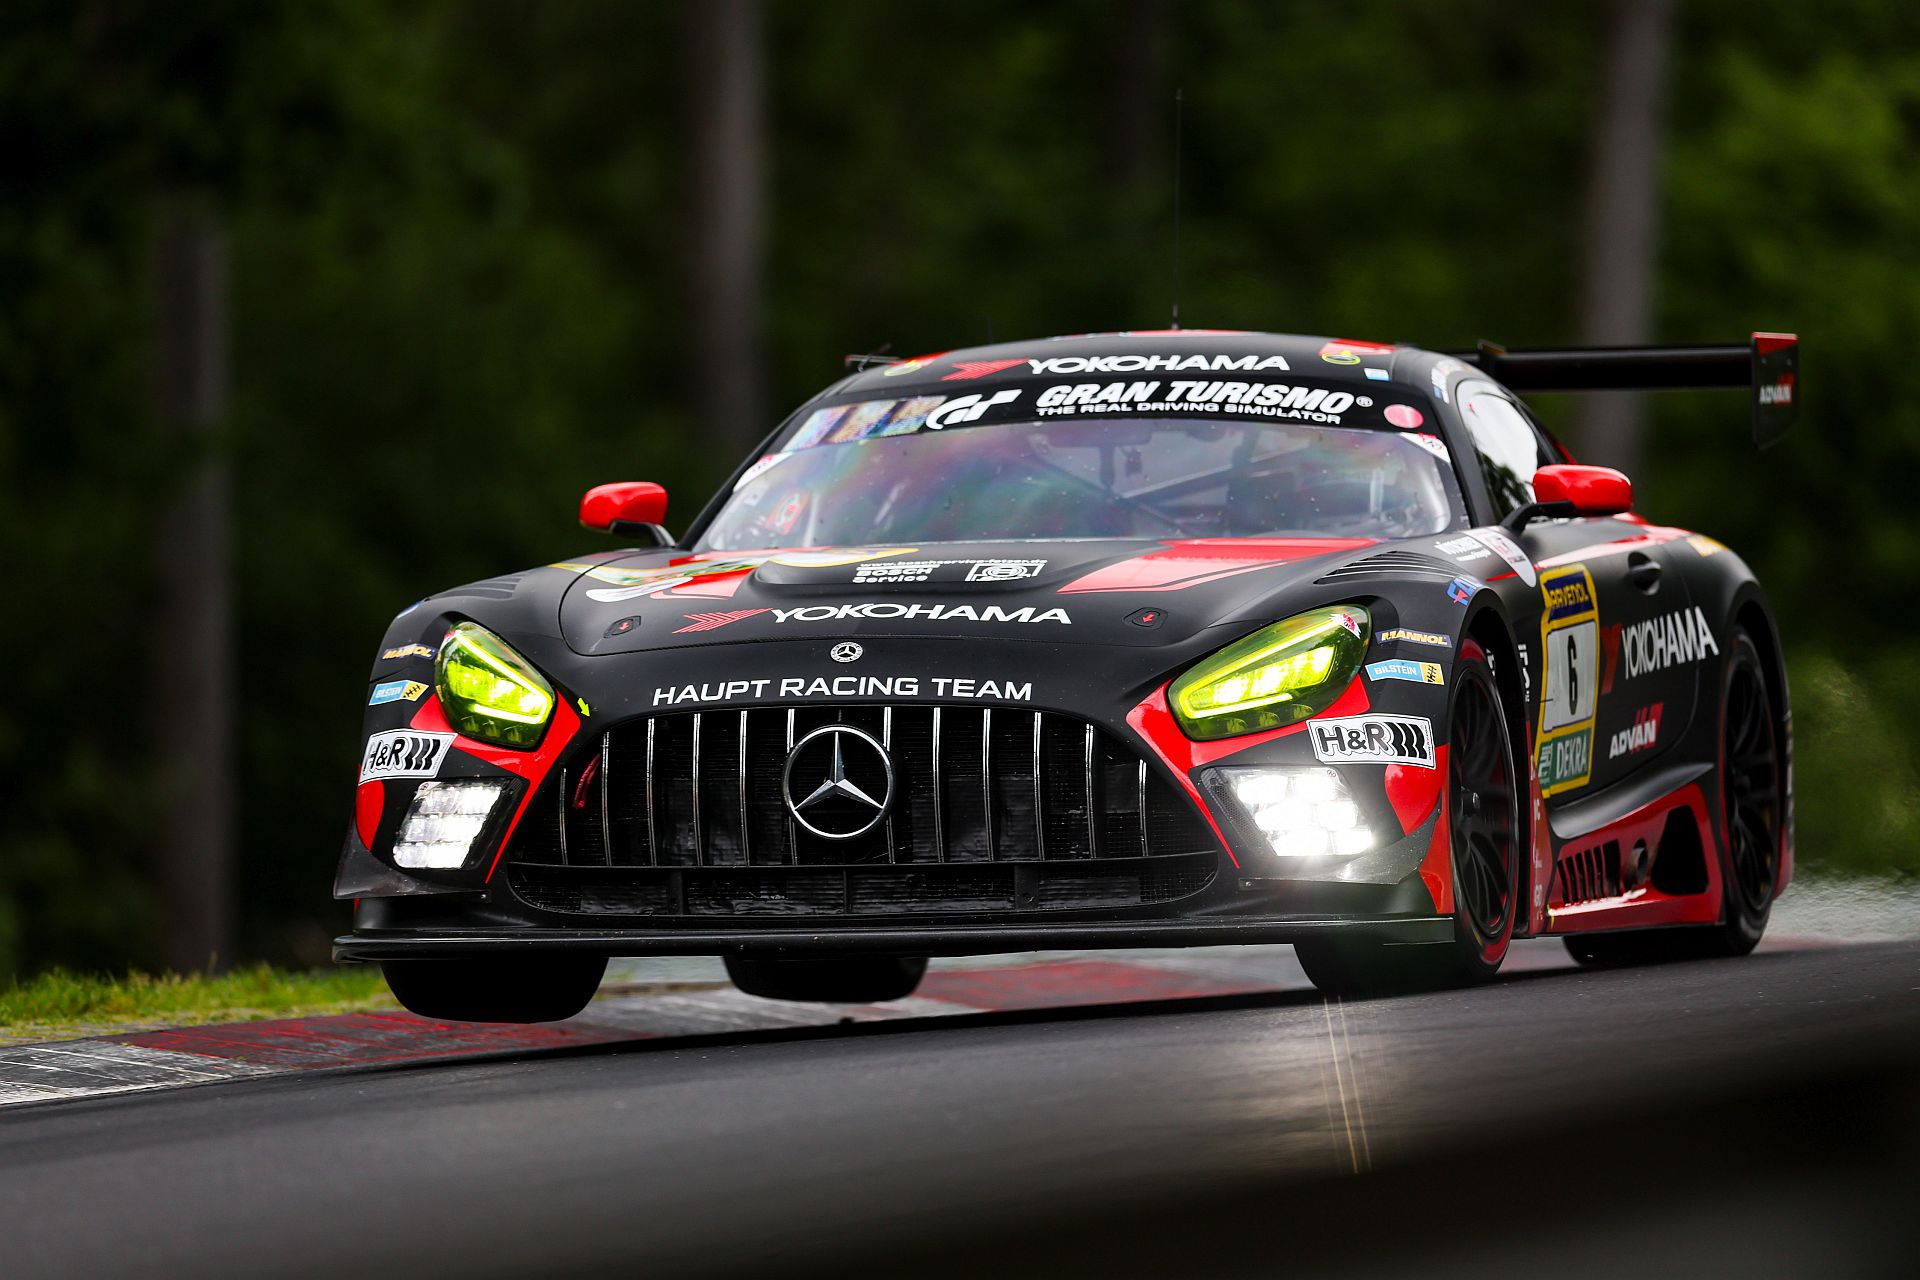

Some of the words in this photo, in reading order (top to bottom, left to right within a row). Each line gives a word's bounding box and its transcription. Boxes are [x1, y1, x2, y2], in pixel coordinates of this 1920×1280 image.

[1029, 355, 1290, 374] YOKOHAMA
[1036, 380, 1161, 407] GRAN
[1036, 405, 1076, 416] THE
[1080, 403, 1129, 414] REAL
[1137, 402, 1220, 412] DRIVING
[1223, 403, 1342, 424] SIMULATOR
[852, 575, 929, 583] Service
[856, 568, 934, 577] BOSCH
[771, 603, 1072, 625] YOKOHAMA
[1381, 630, 1448, 646] MANNOL
[1621, 605, 1720, 680] YOKOHAMA
[1374, 664, 1418, 675] BILSTEIN
[1566, 635, 1577, 715] 6
[652, 680, 771, 706] HAUPT
[779, 677, 919, 697] RACING
[931, 678, 1033, 701] TEAM
[1317, 722, 1390, 754] H&R
[1609, 719, 1656, 760] ADVAN
[363, 737, 405, 774] H&R
[1556, 735, 1588, 780] DEKRA
